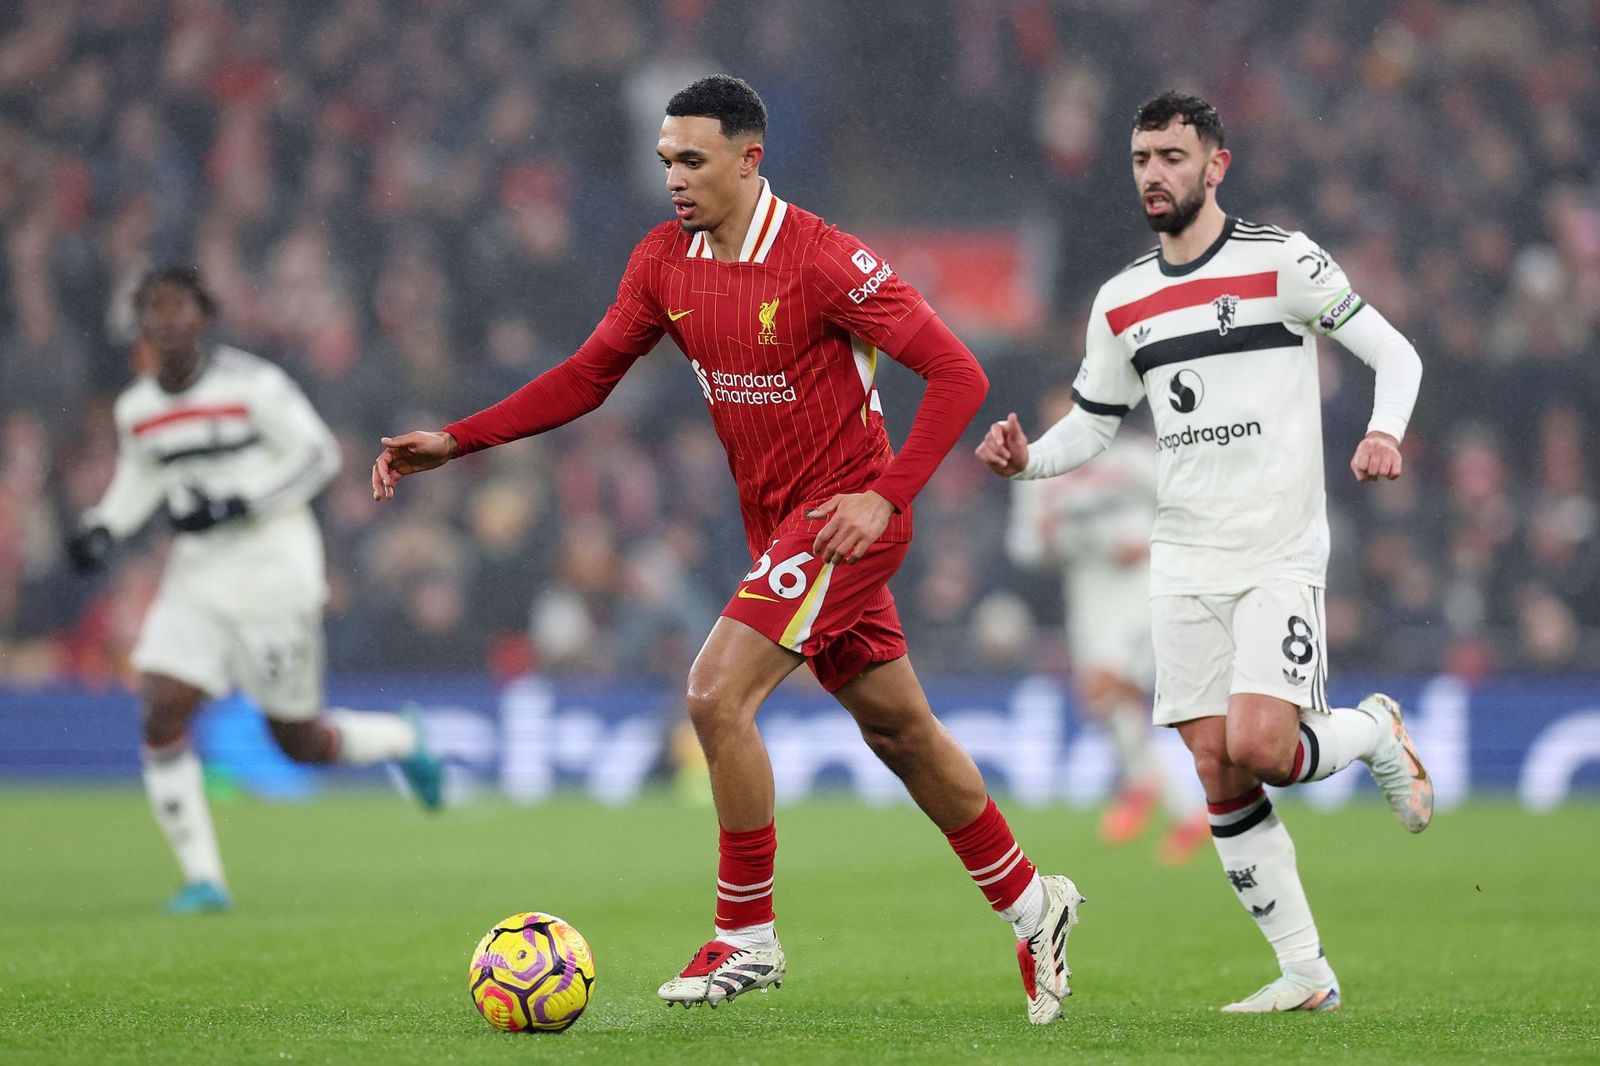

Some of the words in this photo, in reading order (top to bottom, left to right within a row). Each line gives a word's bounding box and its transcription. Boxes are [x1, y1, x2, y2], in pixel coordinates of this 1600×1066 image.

[711, 369, 787, 389] standard
[714, 386, 797, 405] chartered
[1156, 421, 1261, 454] napdragon
[1282, 615, 1313, 665] 8
